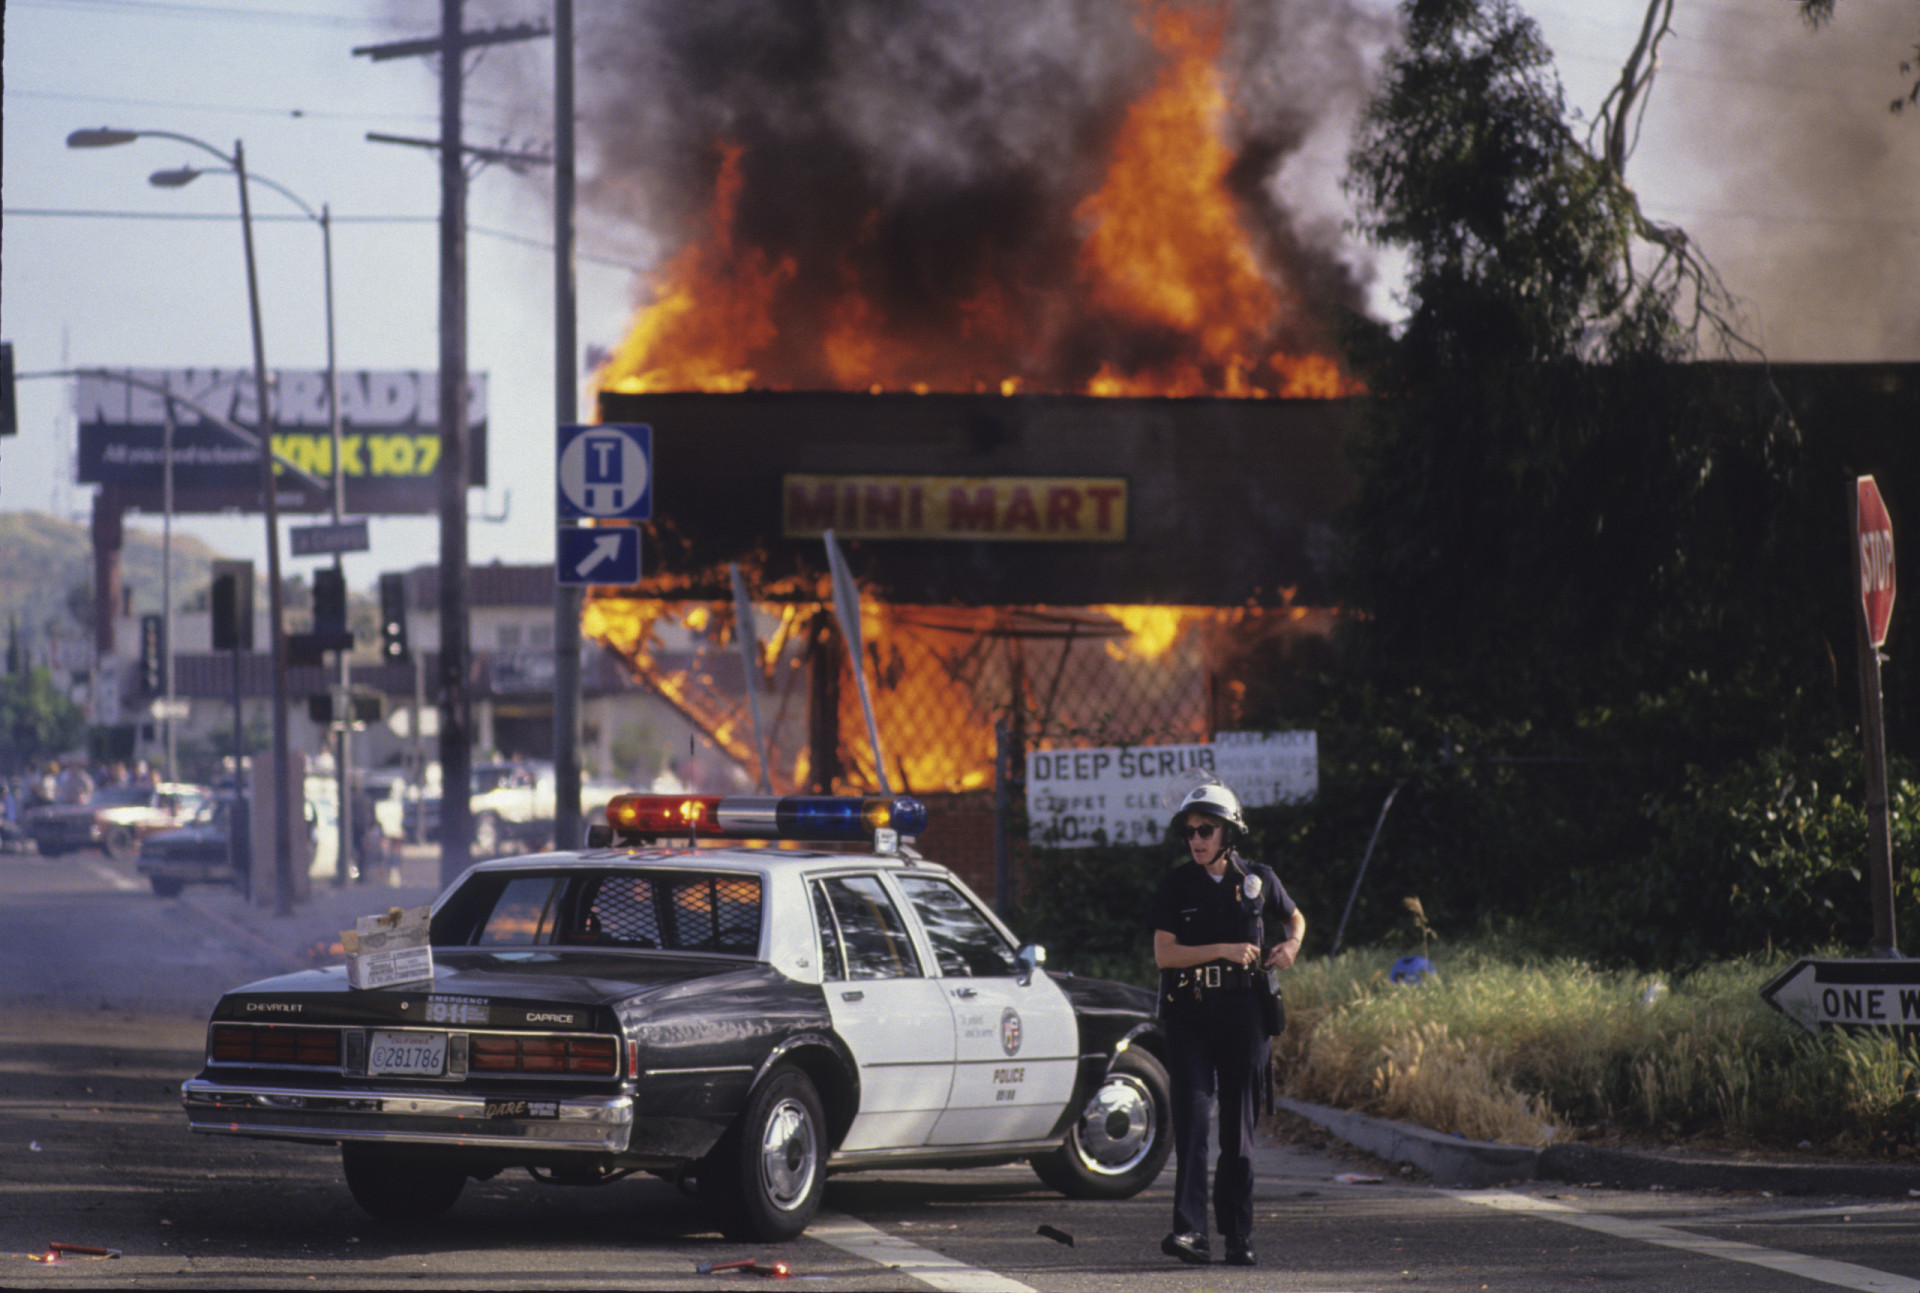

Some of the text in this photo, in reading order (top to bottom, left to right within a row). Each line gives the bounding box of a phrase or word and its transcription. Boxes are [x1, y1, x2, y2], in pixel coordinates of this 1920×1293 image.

[367, 433, 442, 476] 107
[787, 485, 1123, 532] MINI MART
[1861, 529, 1893, 594] STOP
[1034, 753, 1109, 780] DEEP
[1118, 748, 1215, 778] SCRUB
[246, 1003, 303, 1012] CHEVROLET
[428, 995, 489, 1005] EMERGENCY
[1822, 988, 1886, 1019] ONE
[526, 1012, 574, 1024] CAPRICE
[993, 1068, 1026, 1084] POLICE
[486, 1101, 526, 1117] DARE
